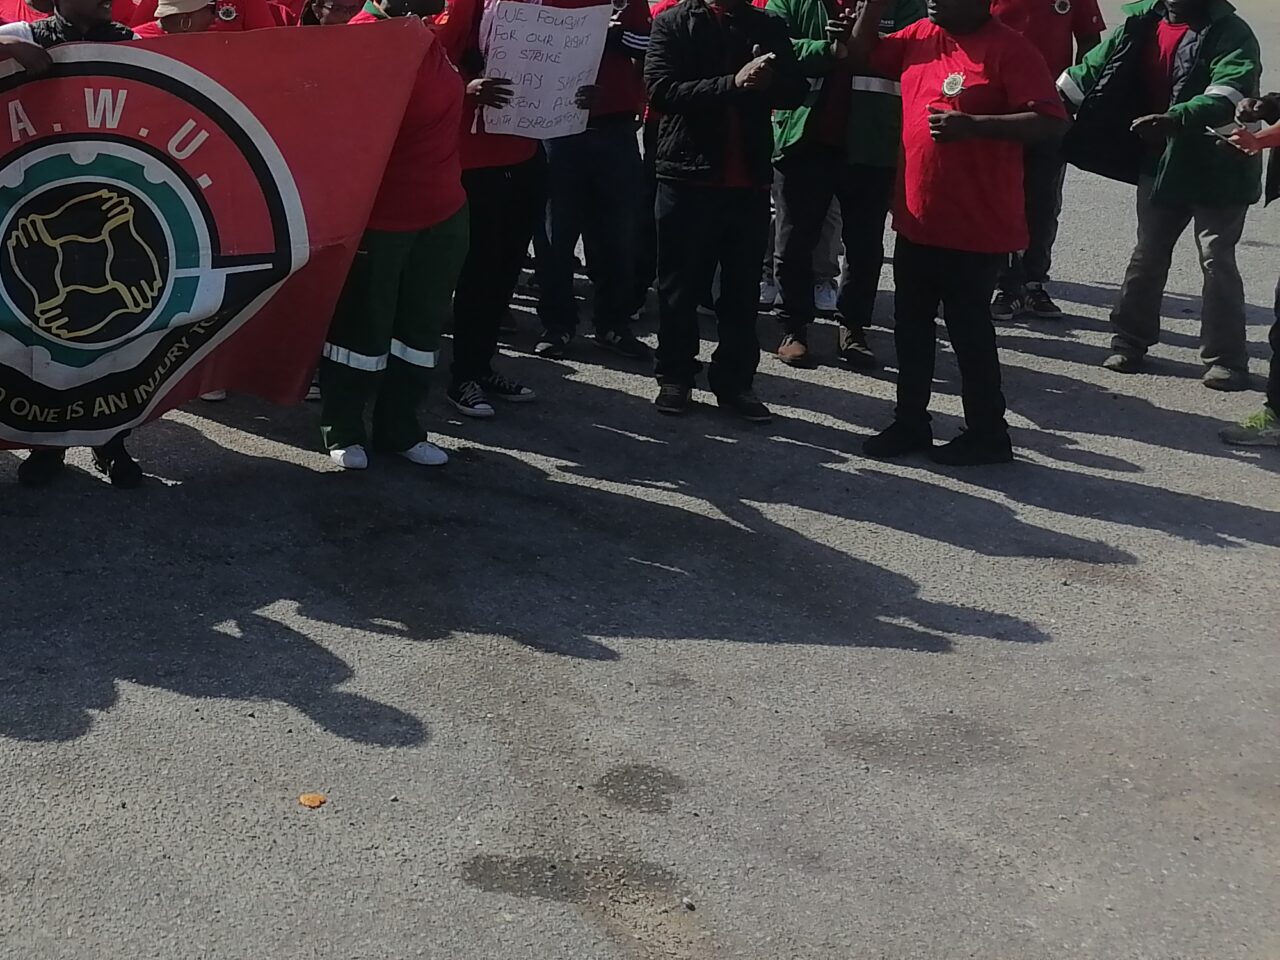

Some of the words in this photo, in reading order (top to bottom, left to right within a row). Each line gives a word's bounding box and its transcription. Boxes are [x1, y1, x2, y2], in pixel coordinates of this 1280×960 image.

[496, 6, 527, 24] WE
[493, 24, 518, 42] FOR
[525, 31, 553, 47] OUR
[492, 46, 507, 60] TO
[519, 49, 563, 64] STRIKE
[10, 397, 61, 423] ONE
[66, 400, 85, 420] IS
[92, 392, 128, 418] AN
[133, 337, 191, 404] INJURY
